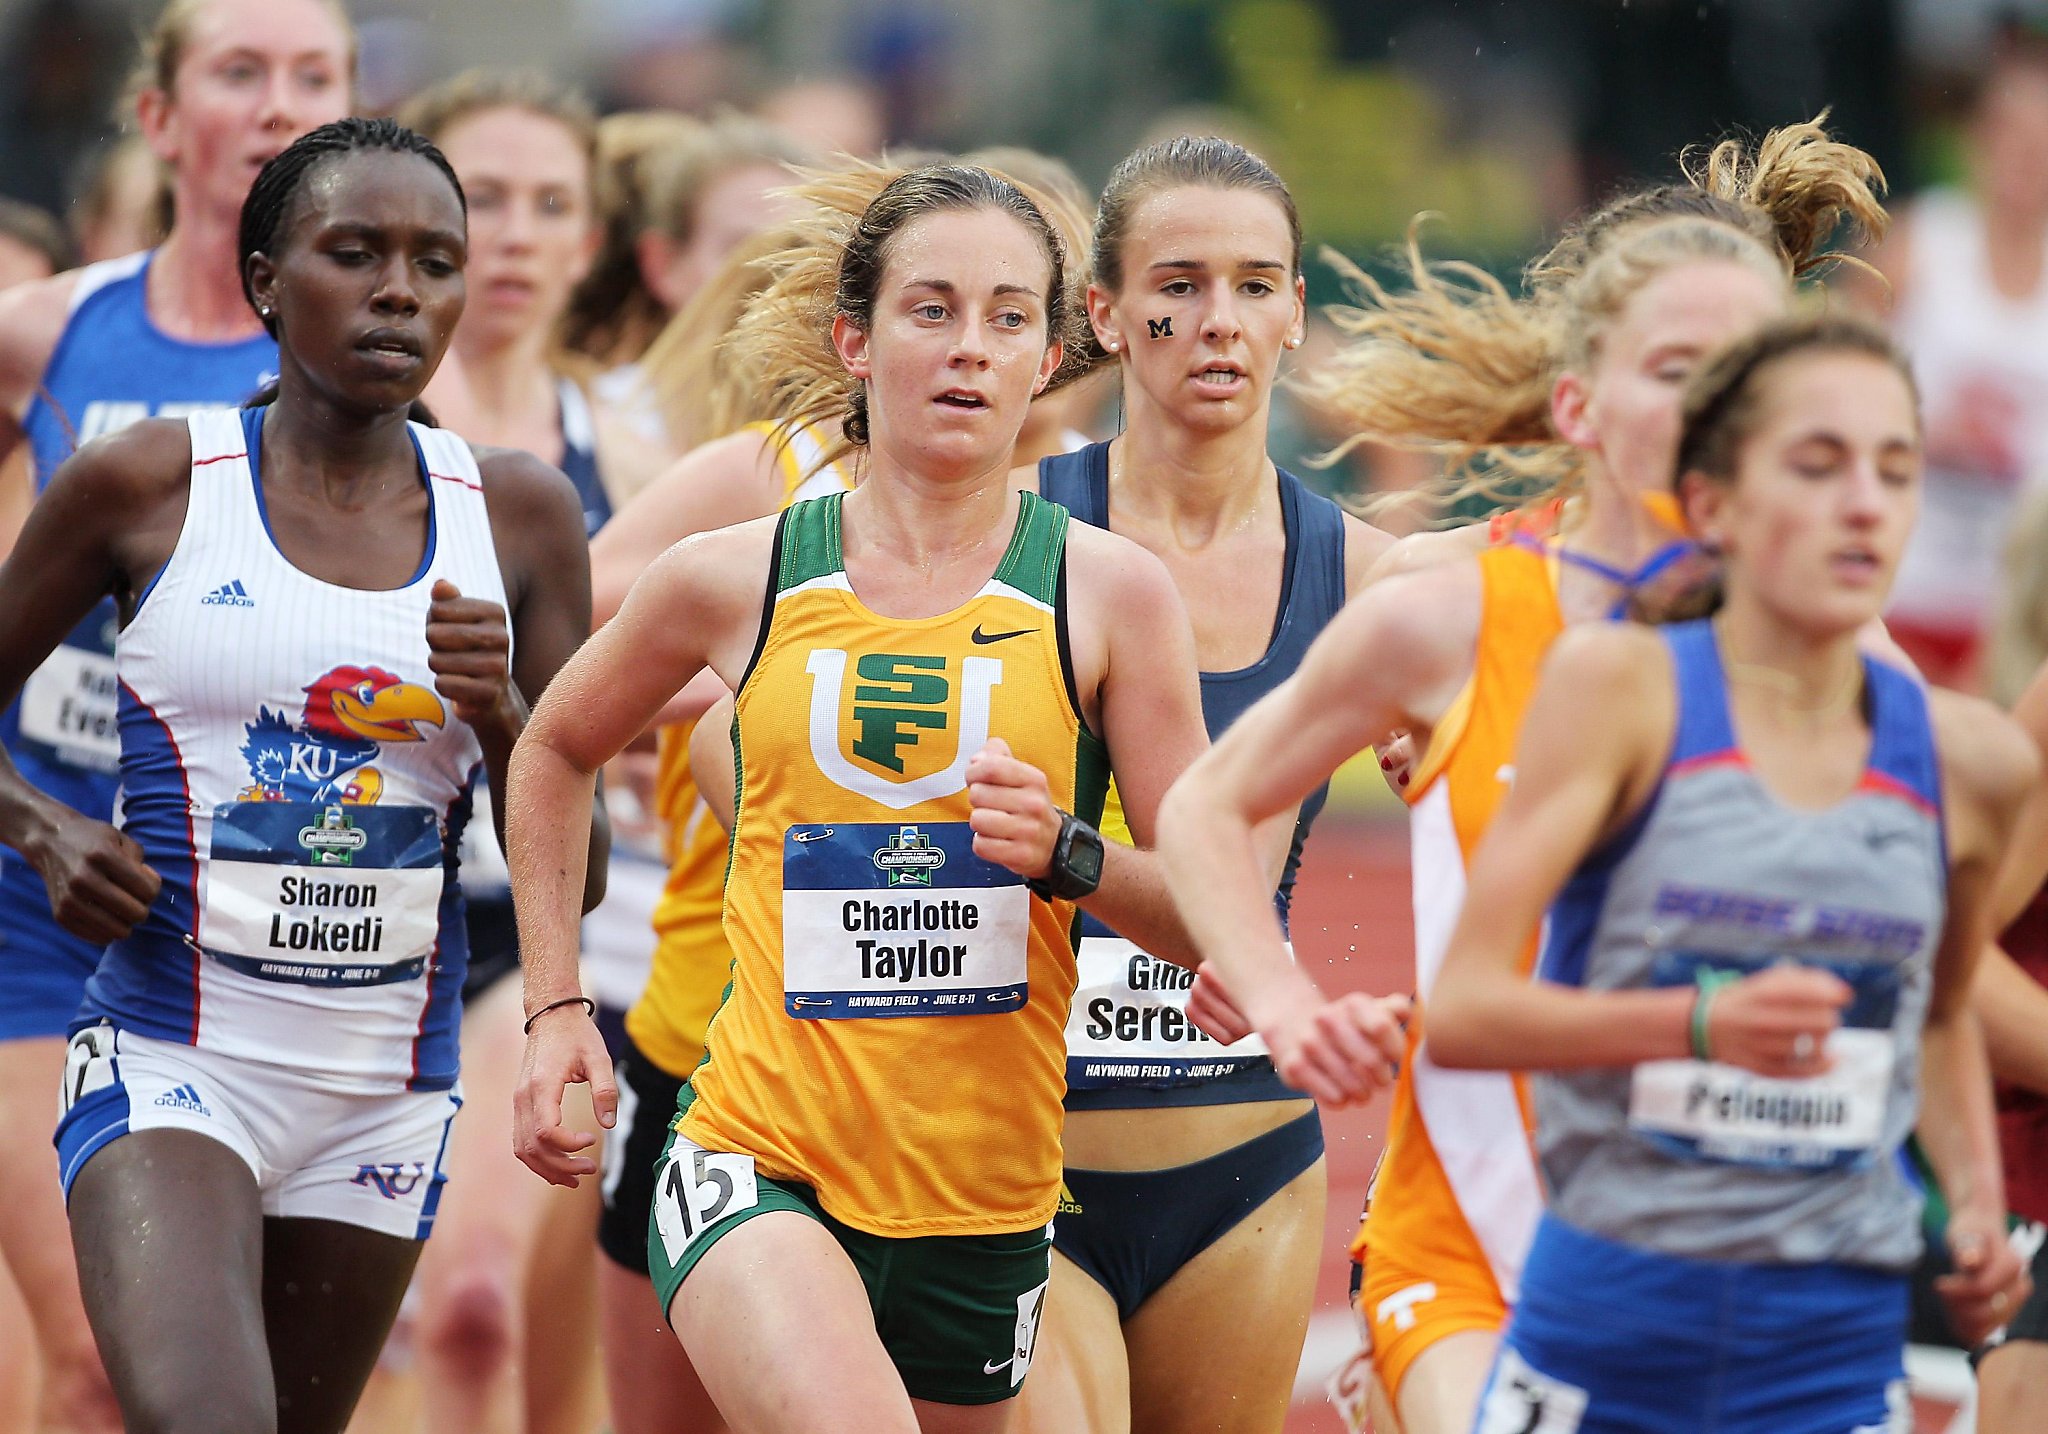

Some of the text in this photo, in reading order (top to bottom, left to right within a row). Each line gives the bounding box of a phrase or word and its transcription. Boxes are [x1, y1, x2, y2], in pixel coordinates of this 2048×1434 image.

[1145, 316, 1174, 339] M
[201, 594, 255, 608] adidas
[287, 742, 338, 782] KU
[881, 855, 939, 864] CHAMPIONSHIPS
[280, 876, 377, 908] Sharon
[842, 899, 979, 932] Charlotte
[269, 913, 383, 952] Lokedi
[260, 963, 304, 976] HAYWARD
[304, 966, 329, 979] FIELD
[341, 968, 364, 980] JUNE
[856, 939, 967, 983] Taylor
[1127, 954, 1196, 991] Gina
[848, 993, 976, 1008] HAYWARD FIELD JUNE 8-11
[1085, 1063, 1235, 1078] HAYWARD FIELD JUNE 8-11
[154, 1096, 212, 1118] adidas
[665, 1150, 734, 1240] 15
[1377, 1281, 1437, 1330] T
